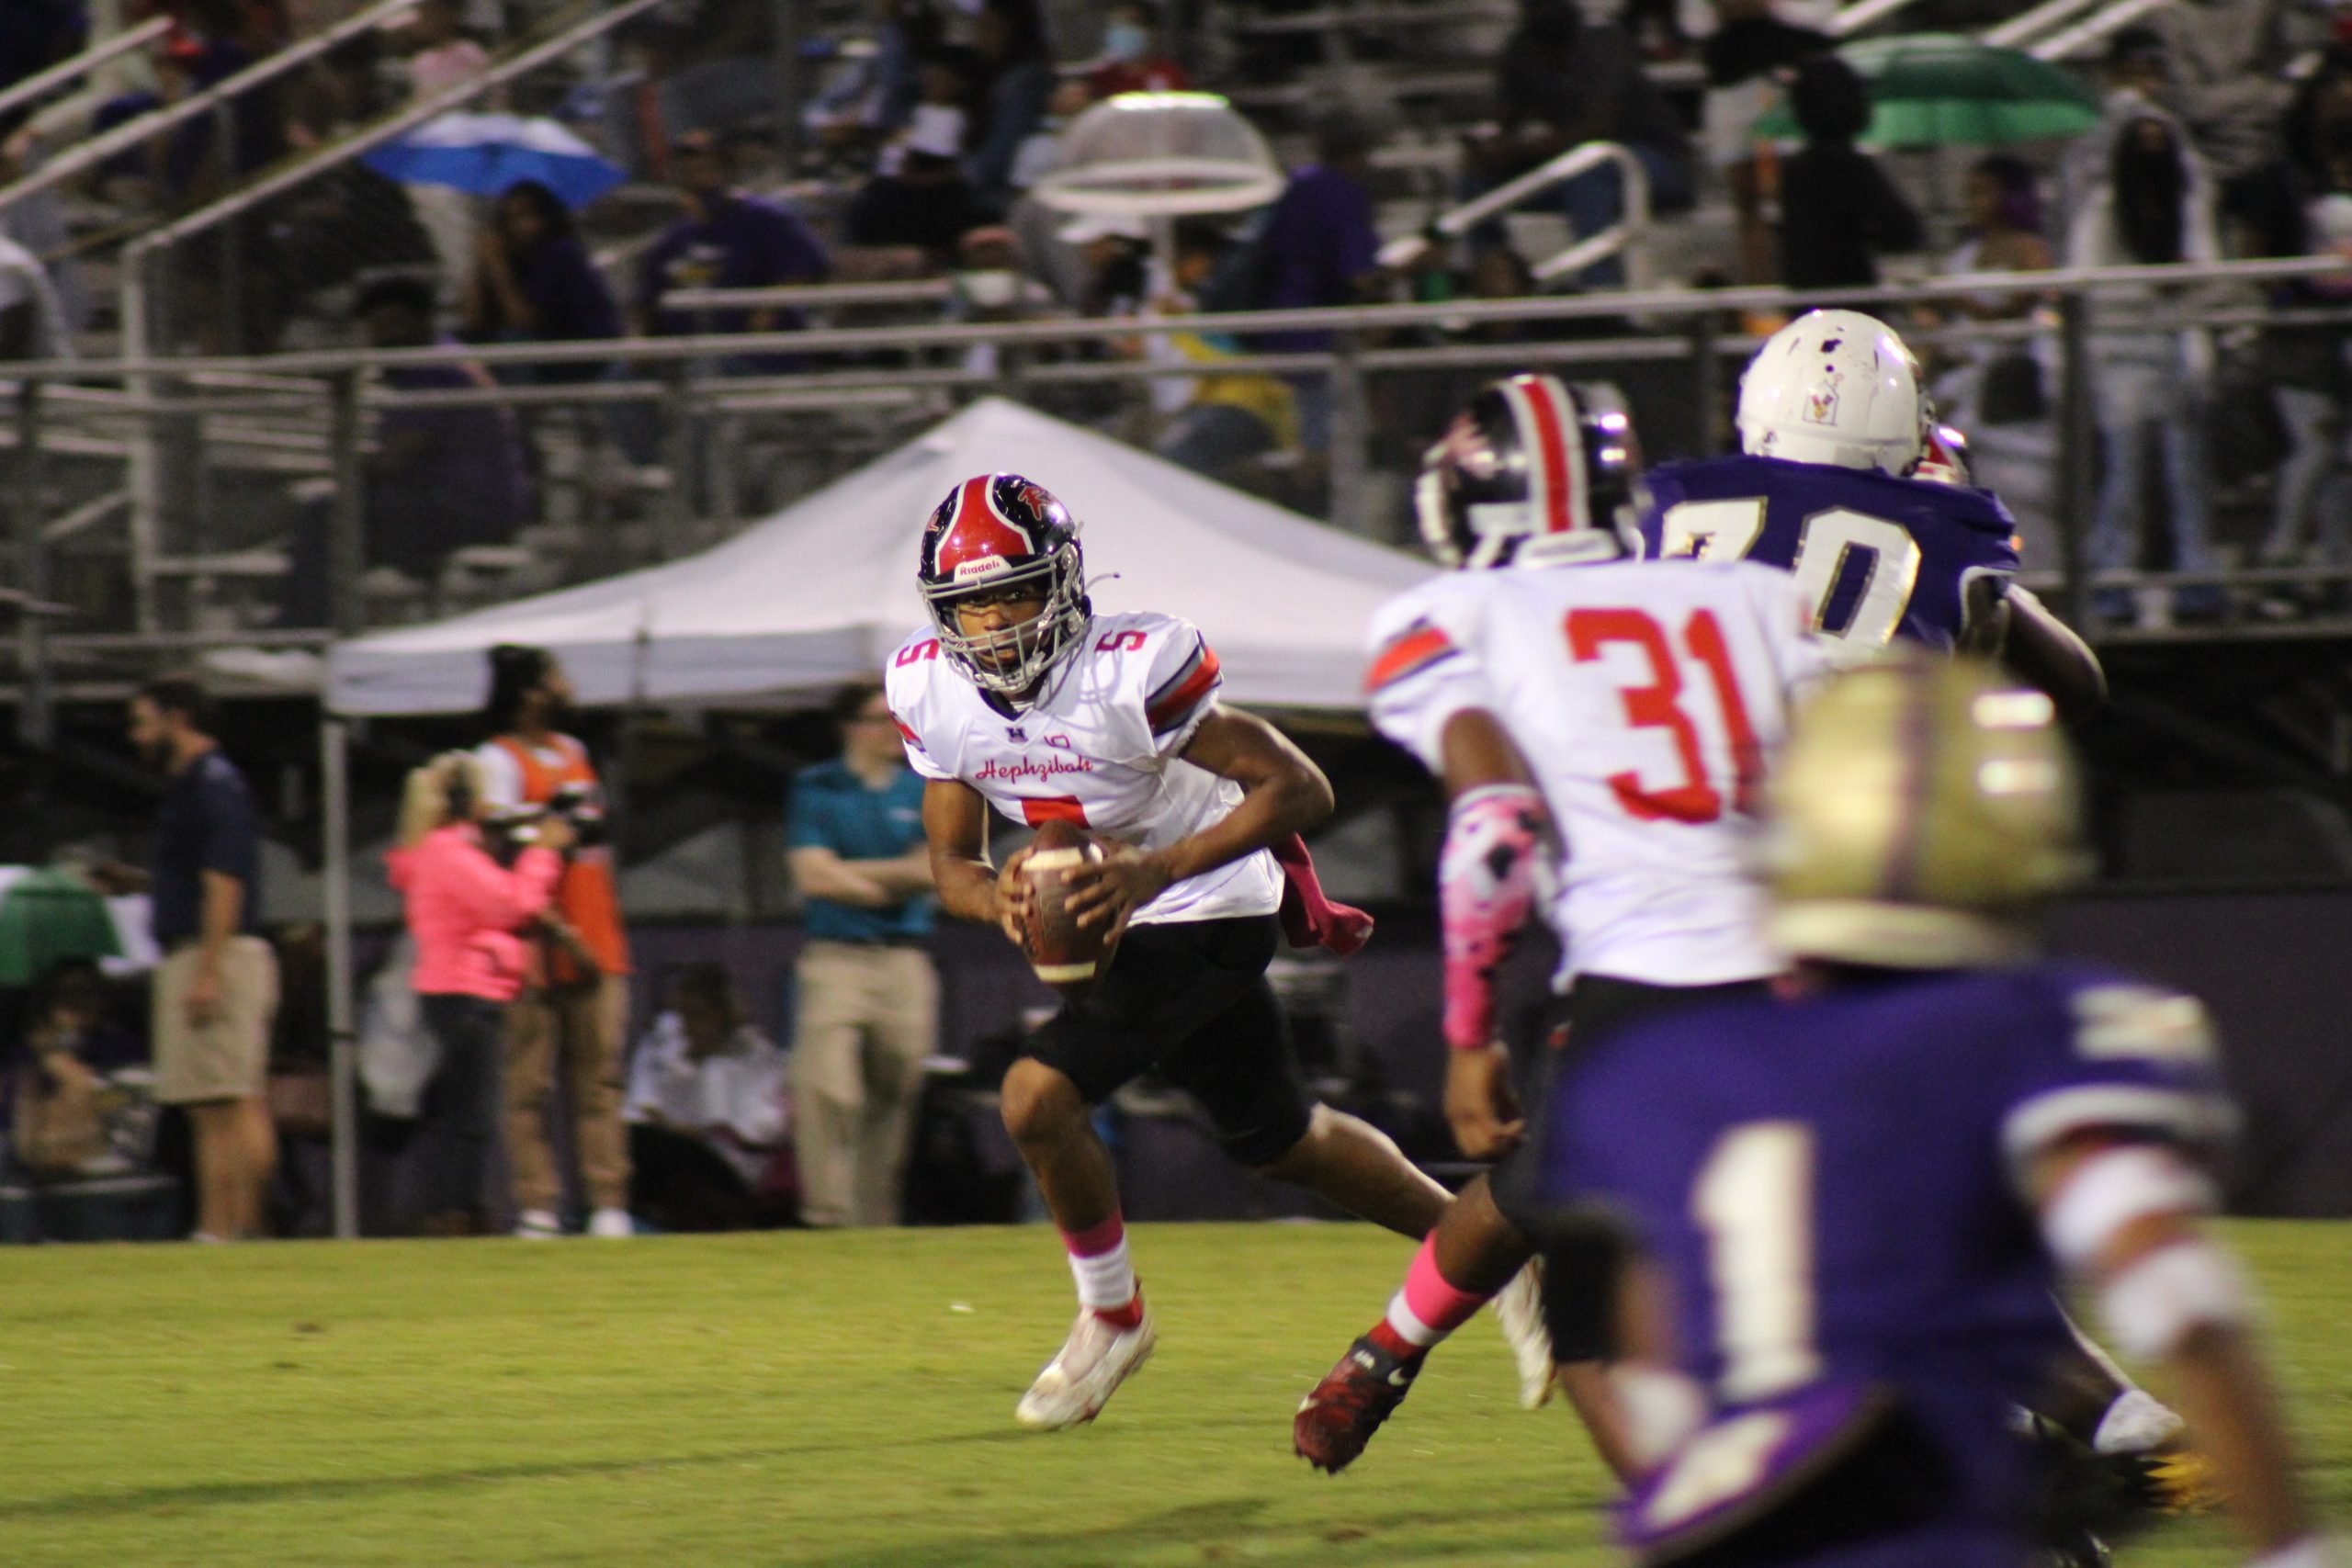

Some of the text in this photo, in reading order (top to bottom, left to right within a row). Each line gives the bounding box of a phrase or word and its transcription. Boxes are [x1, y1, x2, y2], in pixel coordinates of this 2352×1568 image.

[960, 560, 1001, 576] Riddell
[896, 638, 940, 668] 5
[1095, 630, 1147, 651] 5
[1564, 607, 1766, 823] 31
[976, 754, 1092, 784] Hephzibah
[1692, 1121, 1824, 1402] 1
